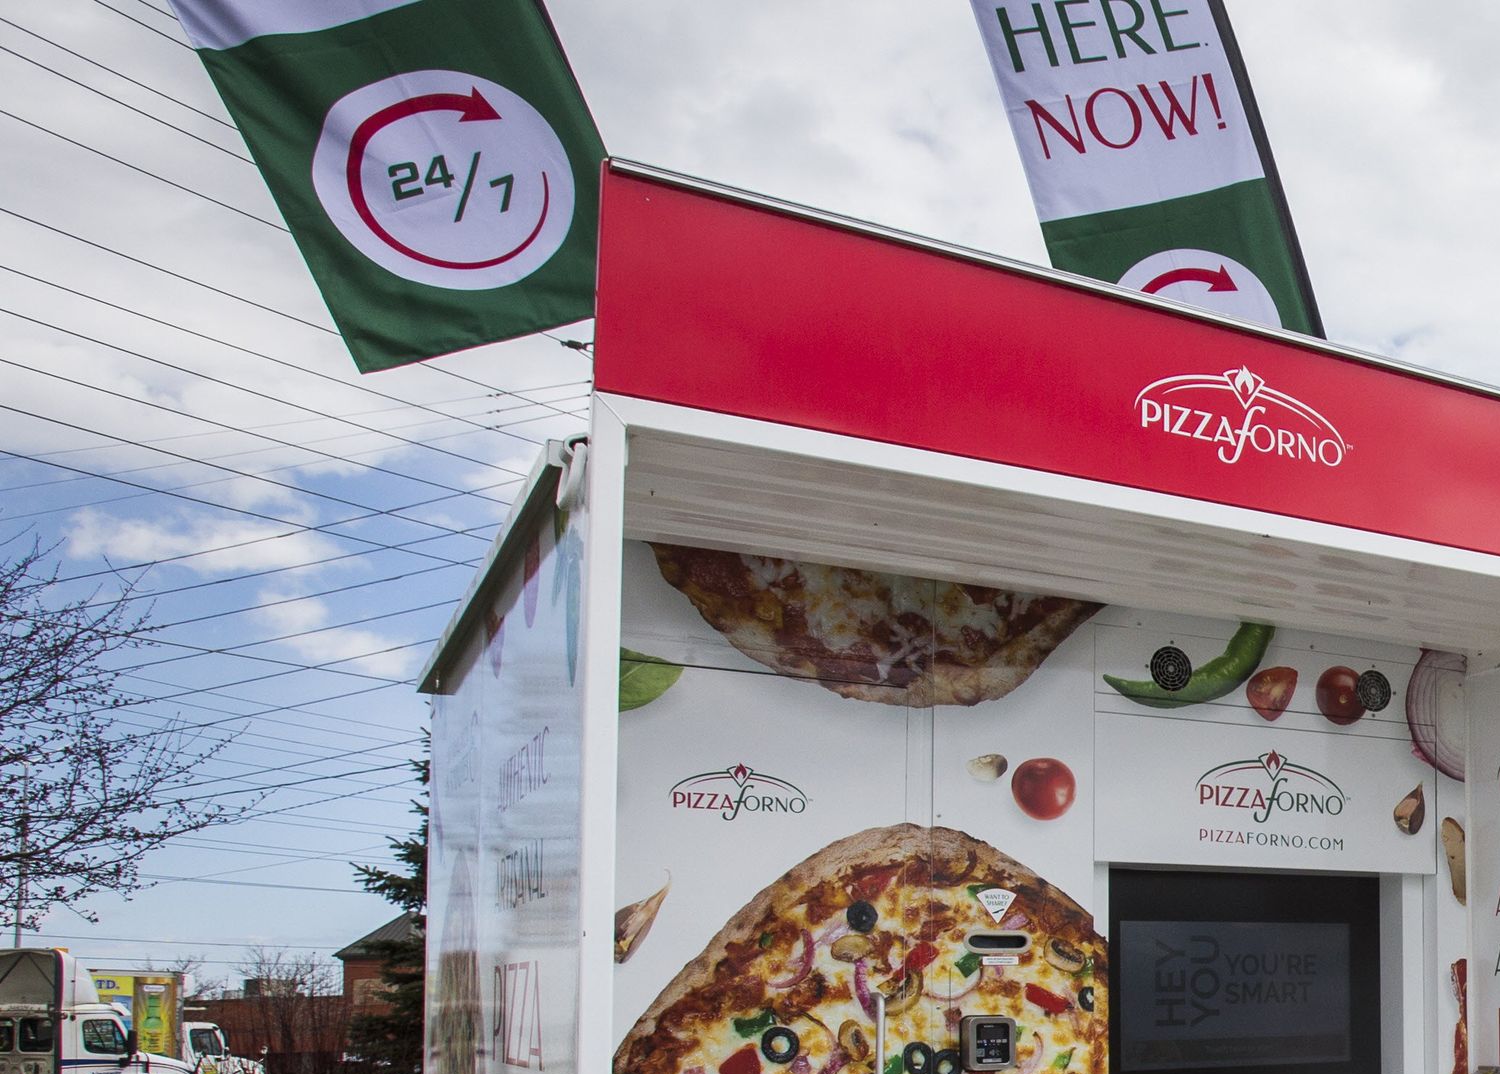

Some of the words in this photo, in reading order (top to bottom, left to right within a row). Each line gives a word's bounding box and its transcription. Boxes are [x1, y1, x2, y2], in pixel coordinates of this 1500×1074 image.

[1024, 73, 1227, 160] NOW!
[388, 151, 515, 223] 24/7
[1199, 828, 1344, 851] PIZZAFORNO.COM
[1155, 939, 1186, 1027] HEY
[1190, 935, 1220, 1027] YOU
[1224, 954, 1317, 976] YOU'RE
[1225, 982, 1313, 1004] SMART
